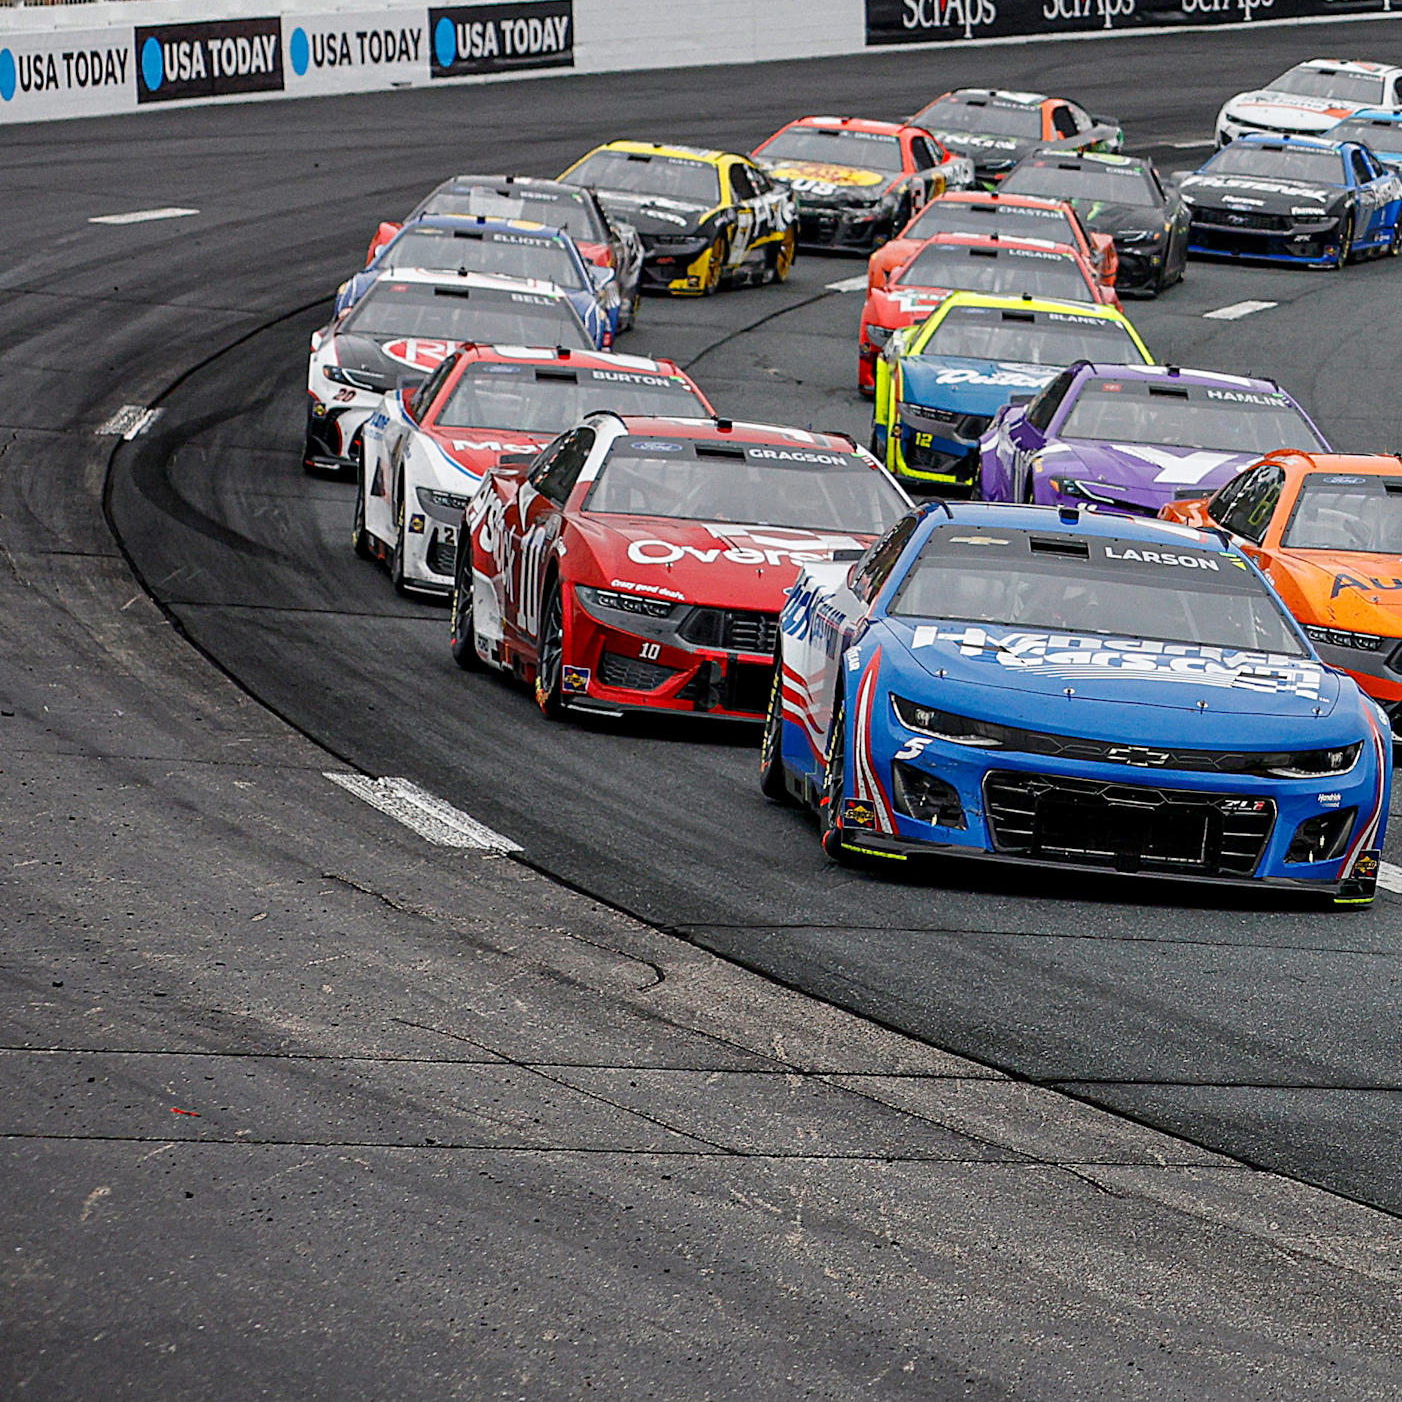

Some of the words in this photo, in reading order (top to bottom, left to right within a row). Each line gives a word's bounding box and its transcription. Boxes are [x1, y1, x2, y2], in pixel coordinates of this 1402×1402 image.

[455, 20, 499, 59] USA
[500, 14, 570, 55] TODAY
[311, 34, 350, 68] USA
[355, 28, 423, 64] TODAY
[163, 39, 208, 82] USA
[207, 34, 278, 76] TODAY
[18, 54, 60, 94] USA
[61, 48, 129, 88] TODAY
[493, 233, 551, 246] ELLIOTT
[1008, 249, 1062, 261] LOGANO
[511, 292, 555, 305] BELL
[1049, 313, 1107, 326] BLANEY
[592, 370, 671, 387] BURTON
[1207, 390, 1287, 407] HAMLIN
[915, 432, 933, 448] 12
[749, 449, 848, 466] GRAGSON
[1105, 546, 1219, 572] LARSON
[611, 579, 637, 592] Crazy
[635, 583, 661, 596] good
[639, 642, 661, 660] 10
[893, 738, 934, 761] 5
